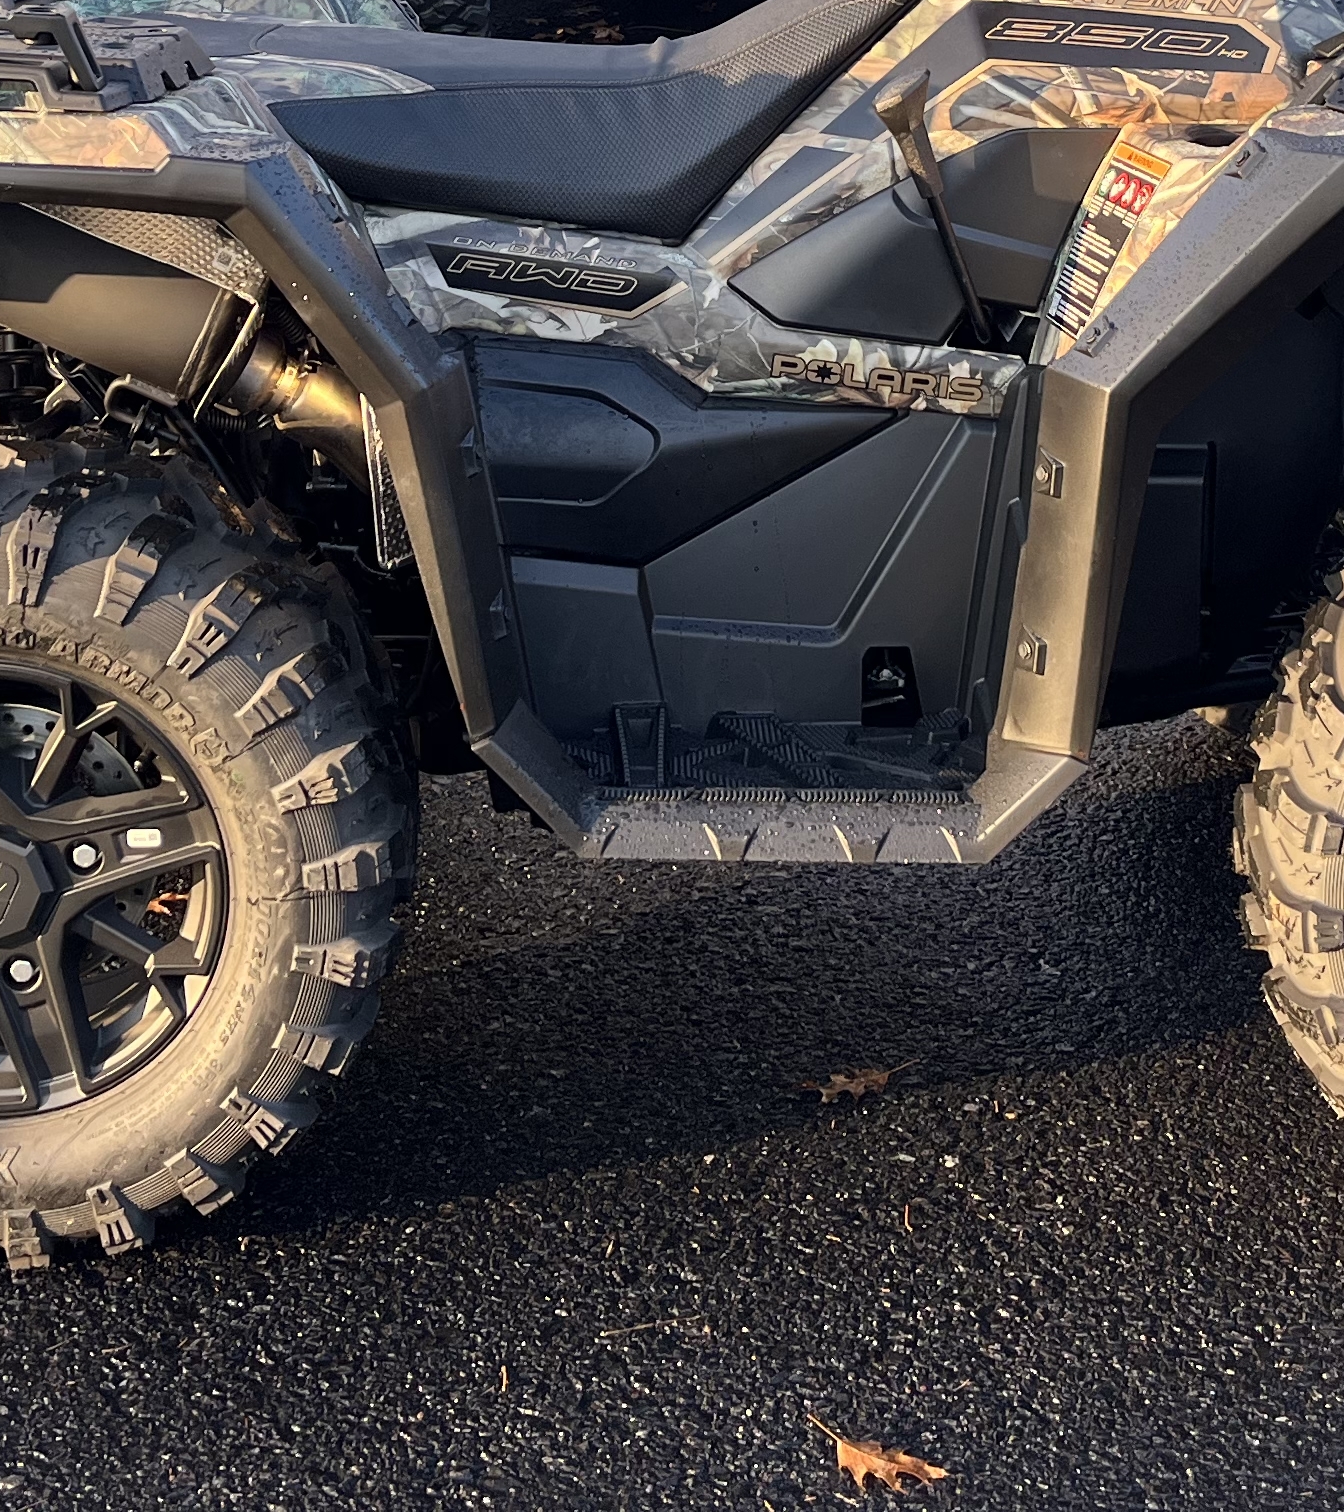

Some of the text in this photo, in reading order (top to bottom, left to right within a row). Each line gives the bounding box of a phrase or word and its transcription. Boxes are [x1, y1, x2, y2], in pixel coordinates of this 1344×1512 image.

[985, 18, 1230, 56] 850
[452, 236, 638, 268] ON DEMAND
[447, 252, 639, 296] AWD
[770, 352, 985, 402] POLARIS
